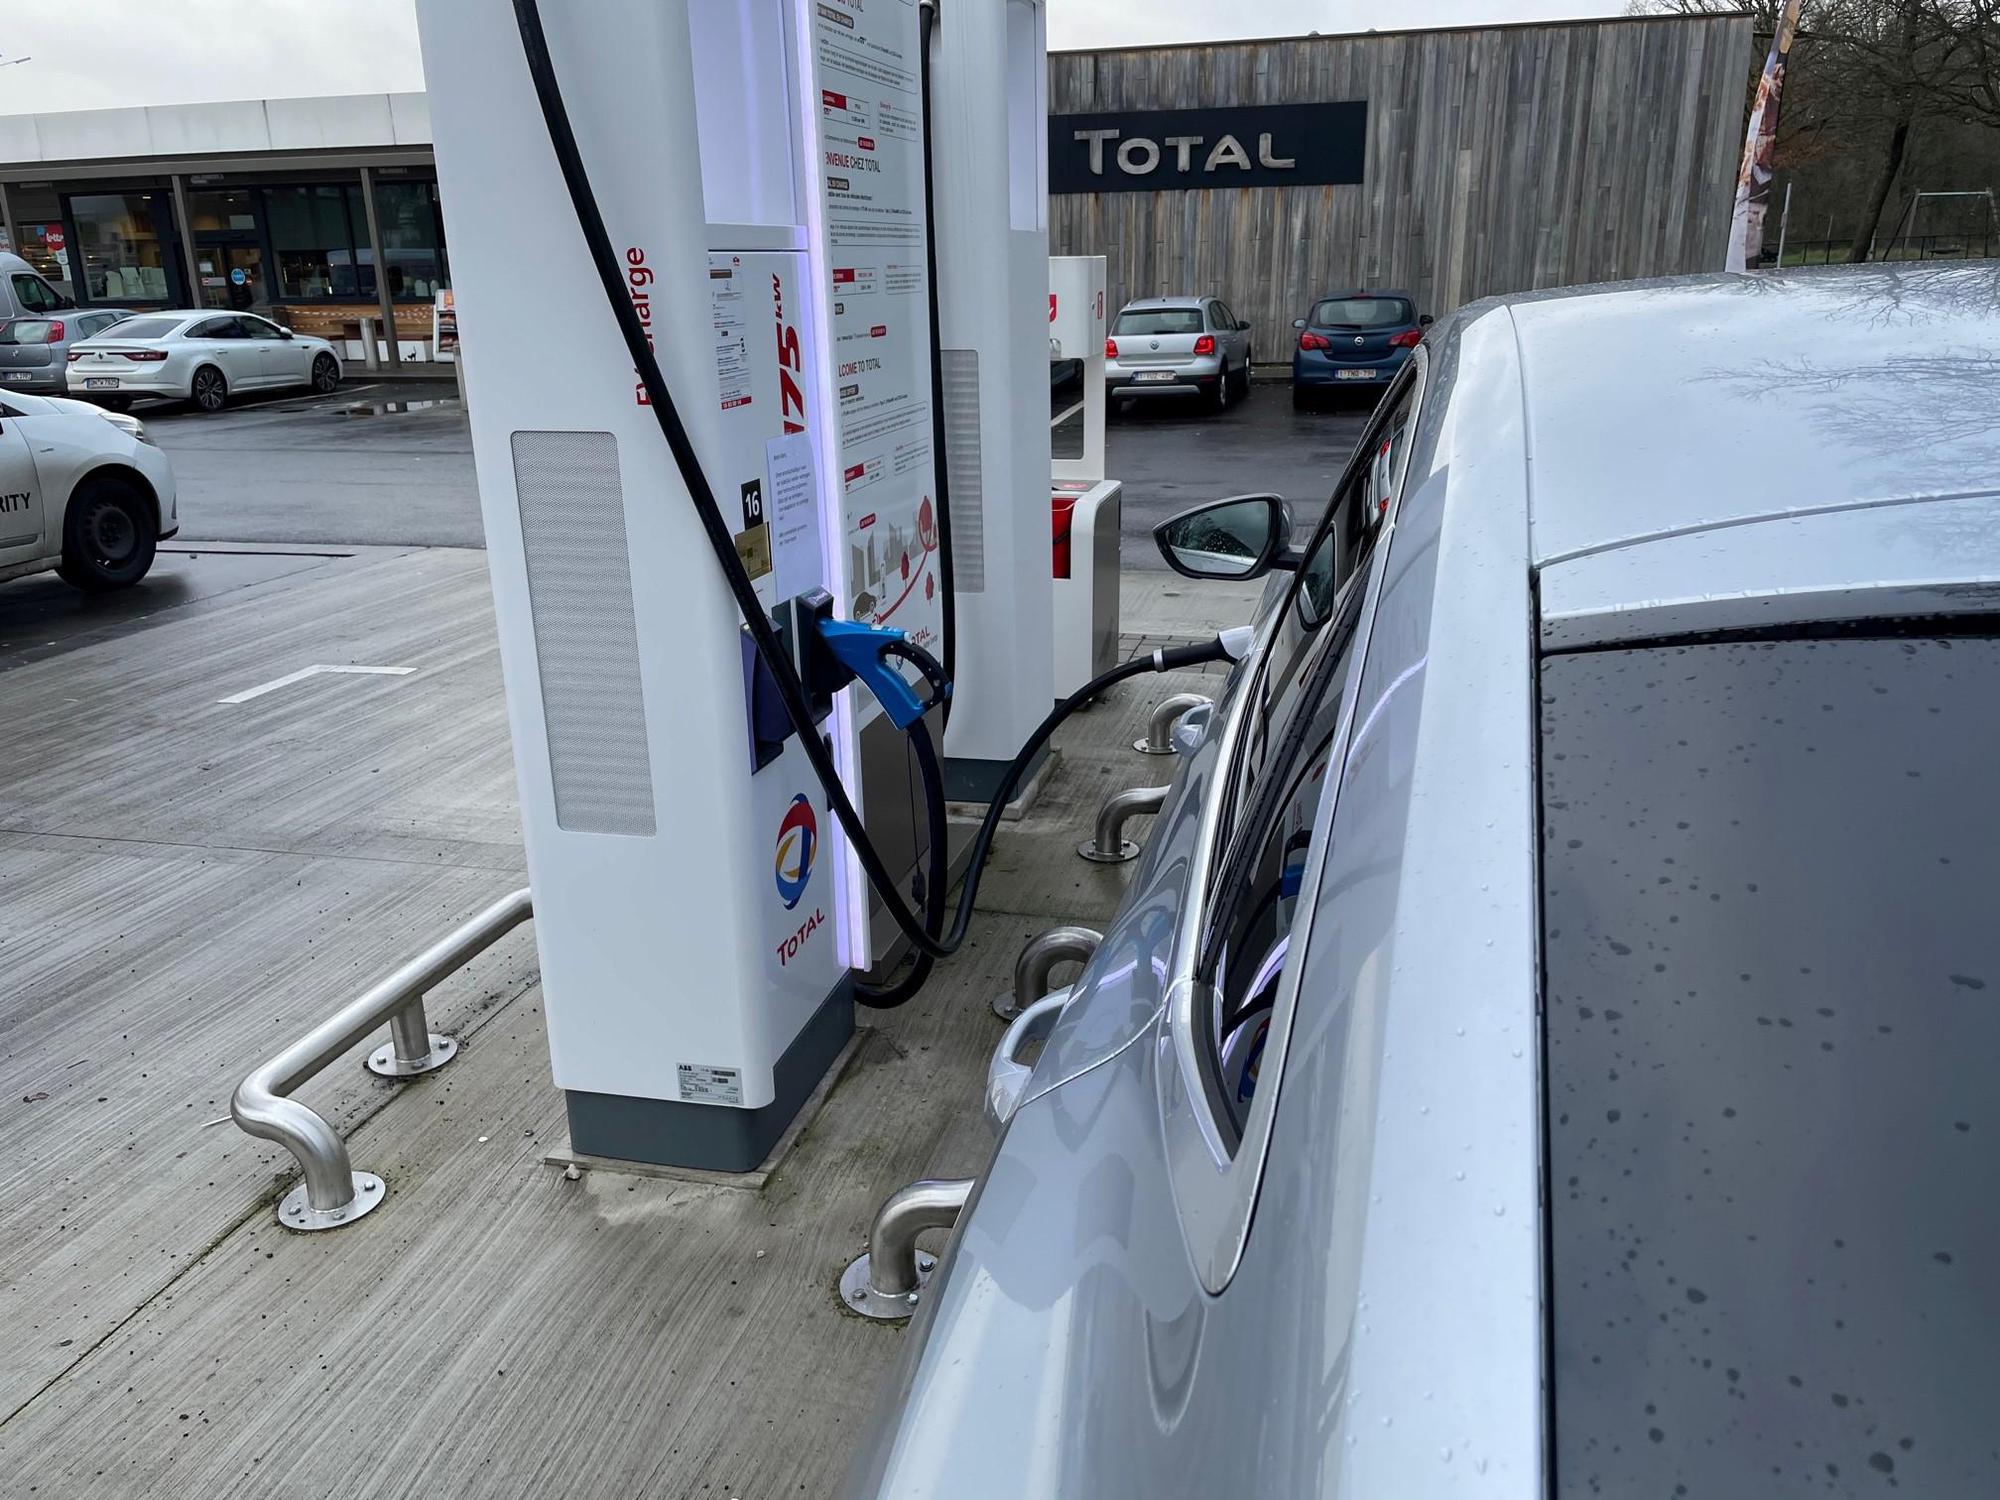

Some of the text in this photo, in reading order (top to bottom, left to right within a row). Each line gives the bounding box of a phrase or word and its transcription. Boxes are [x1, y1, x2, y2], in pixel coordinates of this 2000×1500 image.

[850, 156, 864, 171] CHEZ
[865, 158, 881, 173] TOTAL
[1074, 128, 1295, 175] TOTAL
[866, 357, 881, 371] TOTAL
[745, 491, 760, 518] 16
[776, 908, 825, 967] TOTAL
